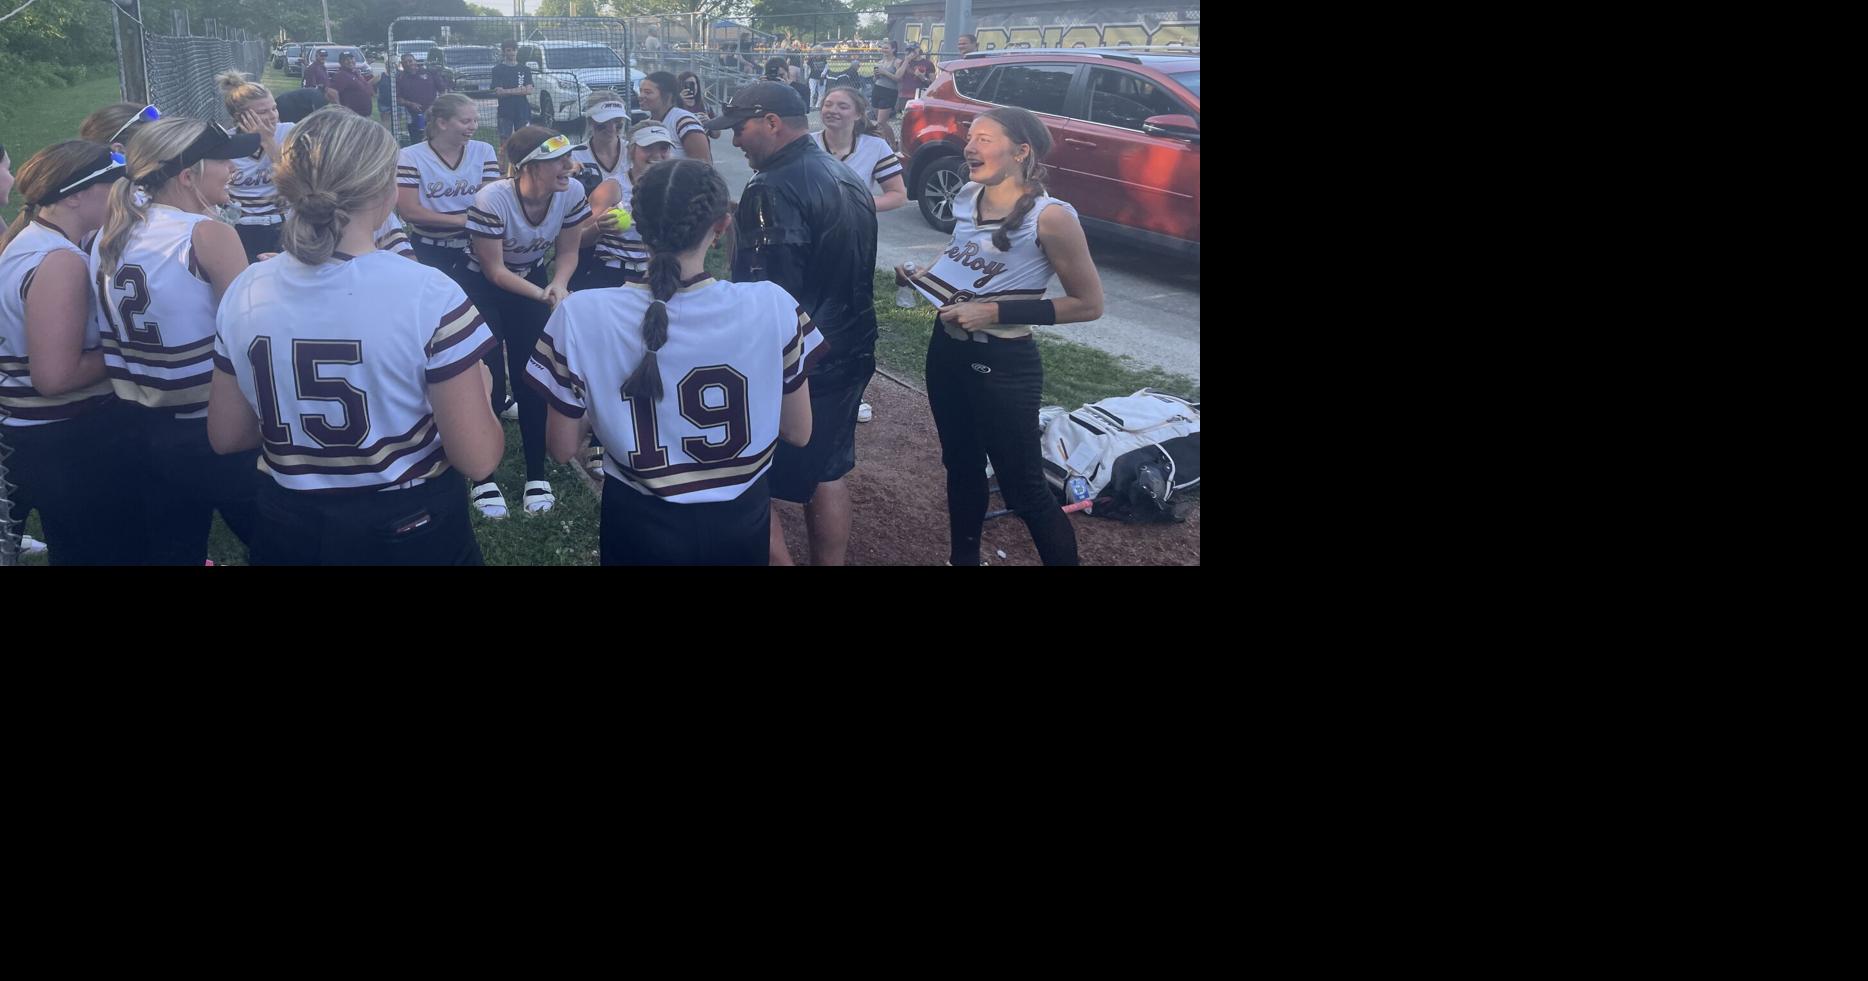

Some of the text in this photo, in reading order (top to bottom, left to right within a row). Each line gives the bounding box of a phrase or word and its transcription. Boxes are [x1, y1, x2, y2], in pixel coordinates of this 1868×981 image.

[944, 240, 1008, 289] eRoy
[247, 335, 371, 448] 15
[620, 363, 752, 472] 19
